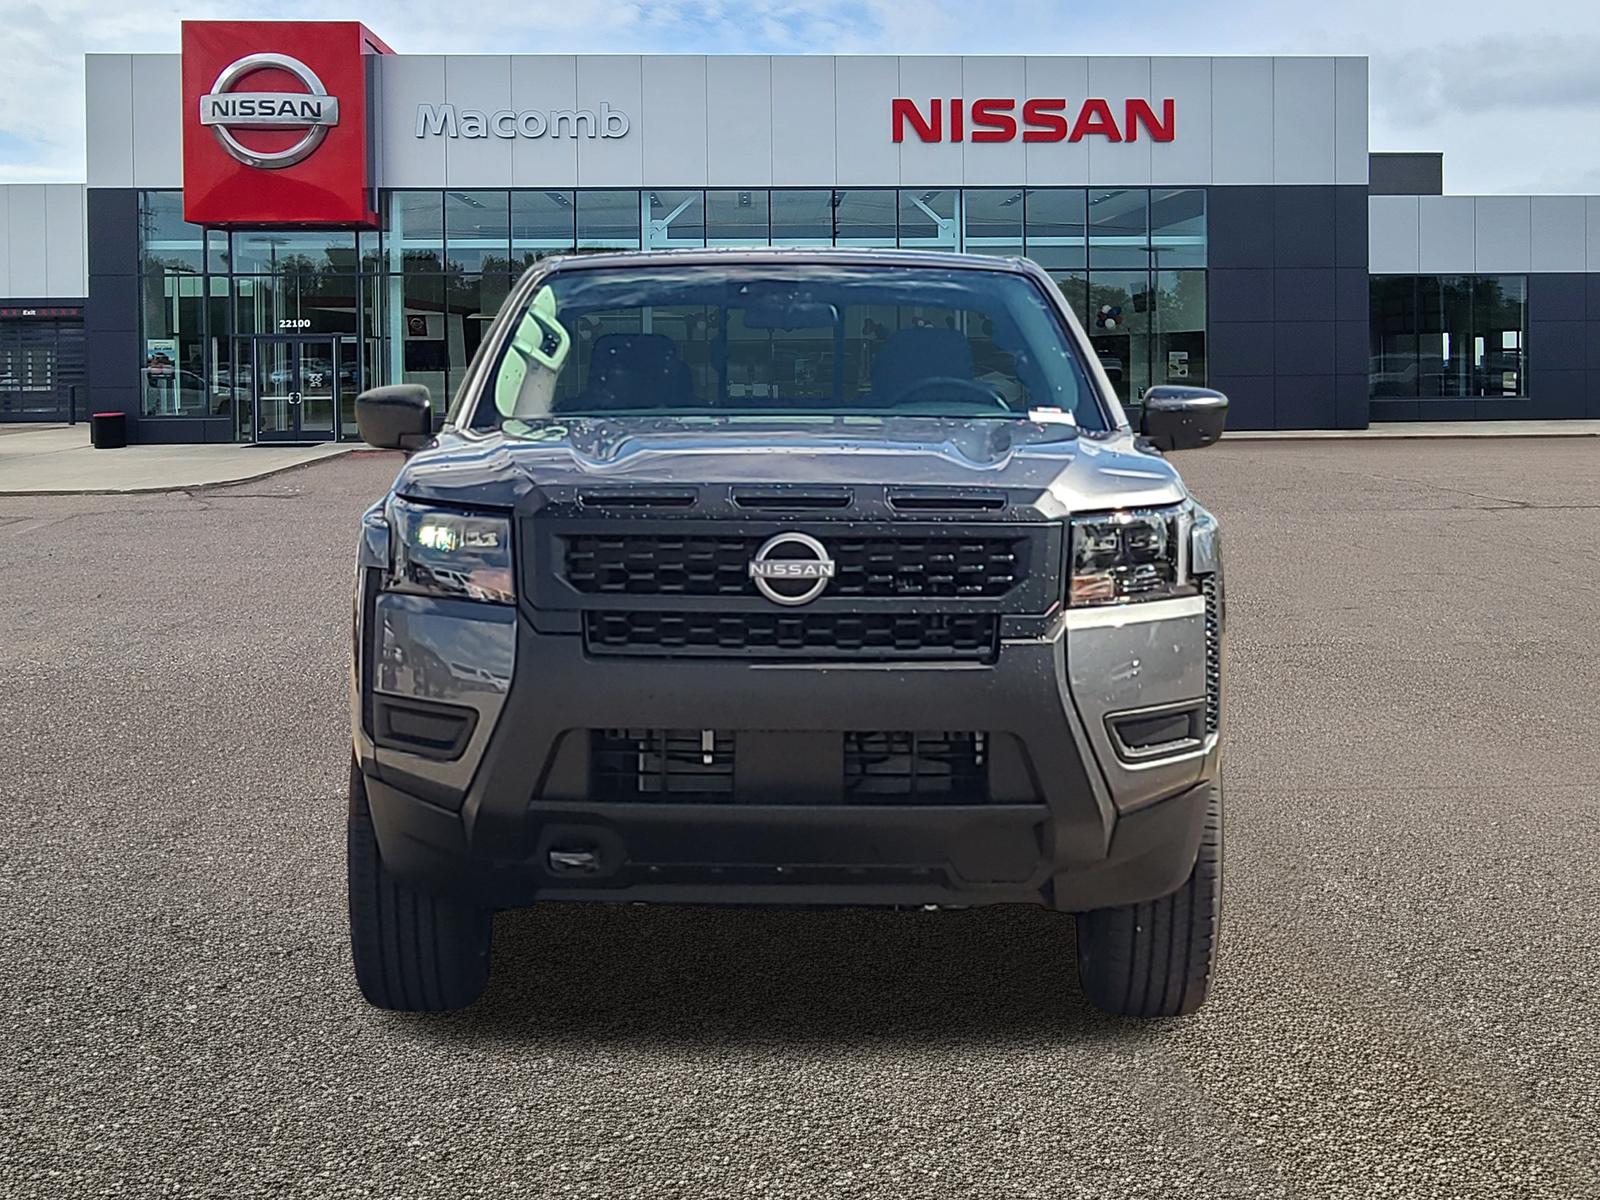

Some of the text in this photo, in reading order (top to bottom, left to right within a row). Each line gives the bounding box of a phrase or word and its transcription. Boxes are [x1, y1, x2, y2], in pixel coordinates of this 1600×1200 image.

[211, 100, 322, 118] NISSAN
[415, 102, 630, 138] Macomb
[892, 98, 1175, 143] NISSAN
[279, 319, 311, 328] 22100
[751, 563, 834, 576] NISSAN
